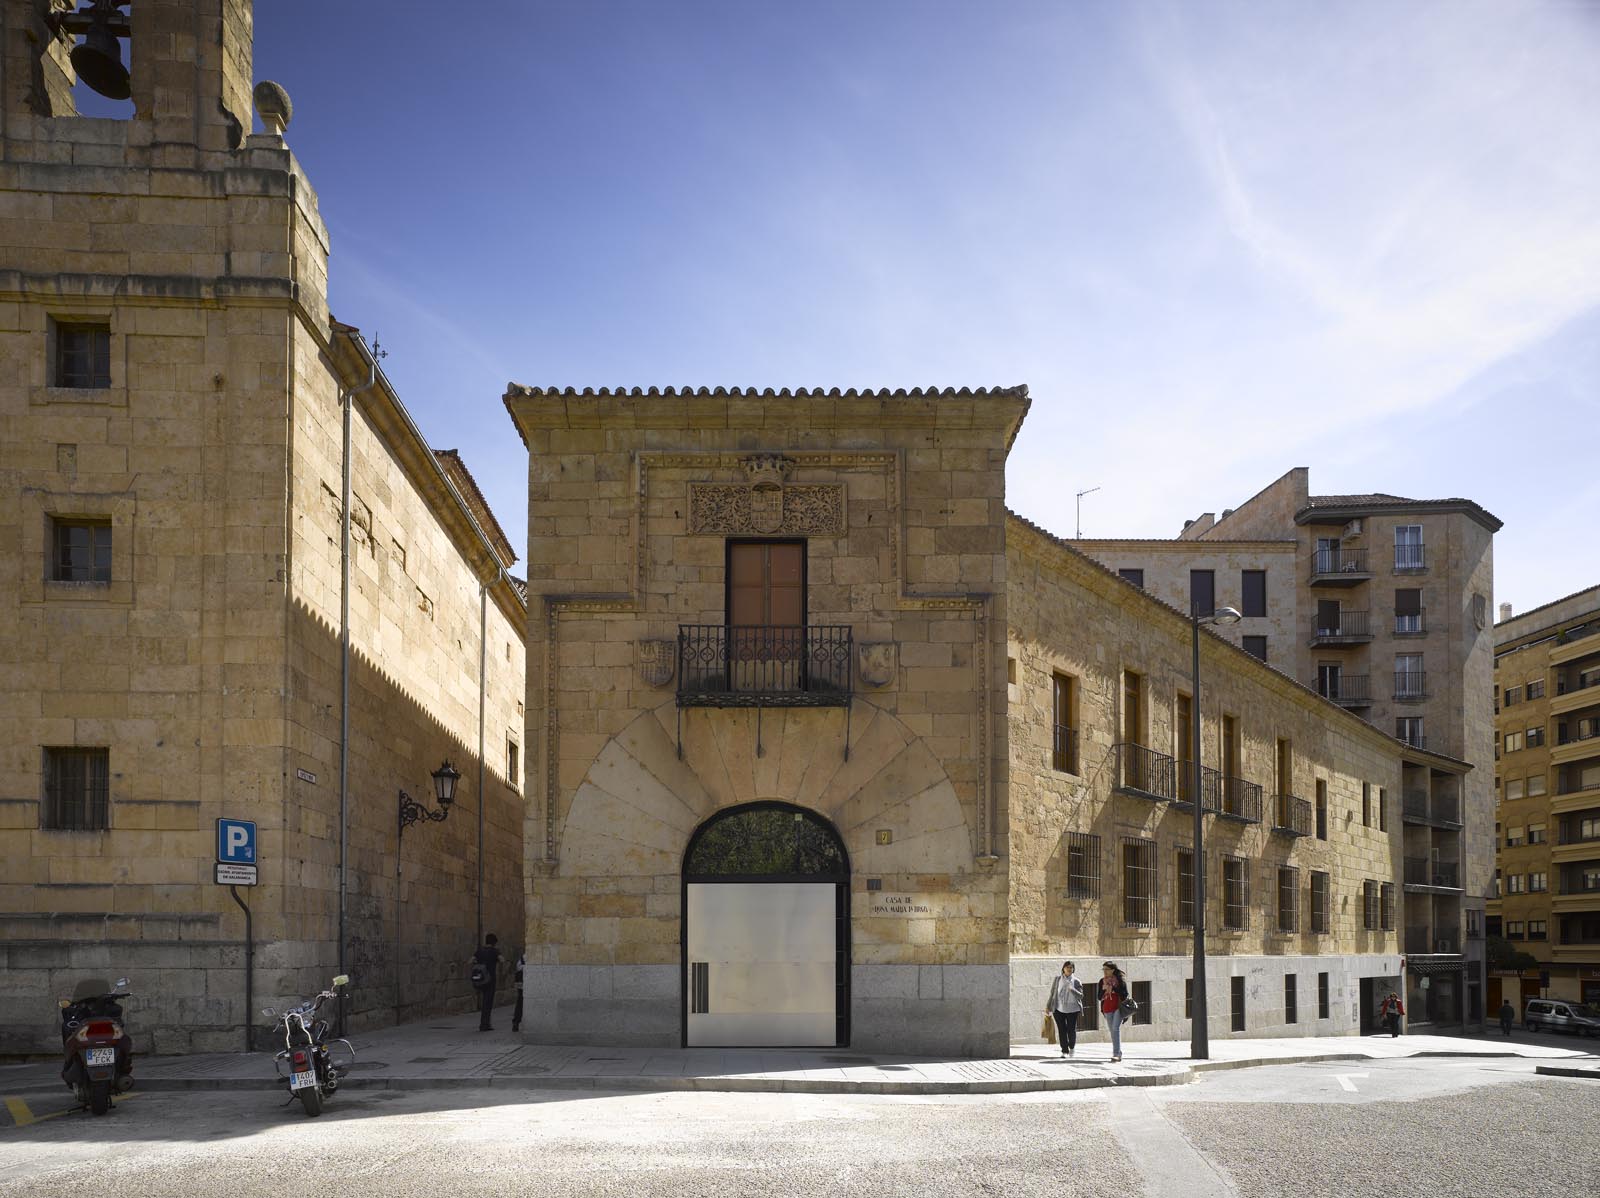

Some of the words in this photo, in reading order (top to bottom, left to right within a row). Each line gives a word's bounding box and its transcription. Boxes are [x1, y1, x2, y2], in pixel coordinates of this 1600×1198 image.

[228, 825, 248, 856] P
[885, 896, 902, 904] CASA
[93, 1048, 112, 1057] 2749
[95, 1056, 111, 1064] FCK
[296, 1070, 314, 1081] 1407
[299, 1078, 314, 1088] FRH
